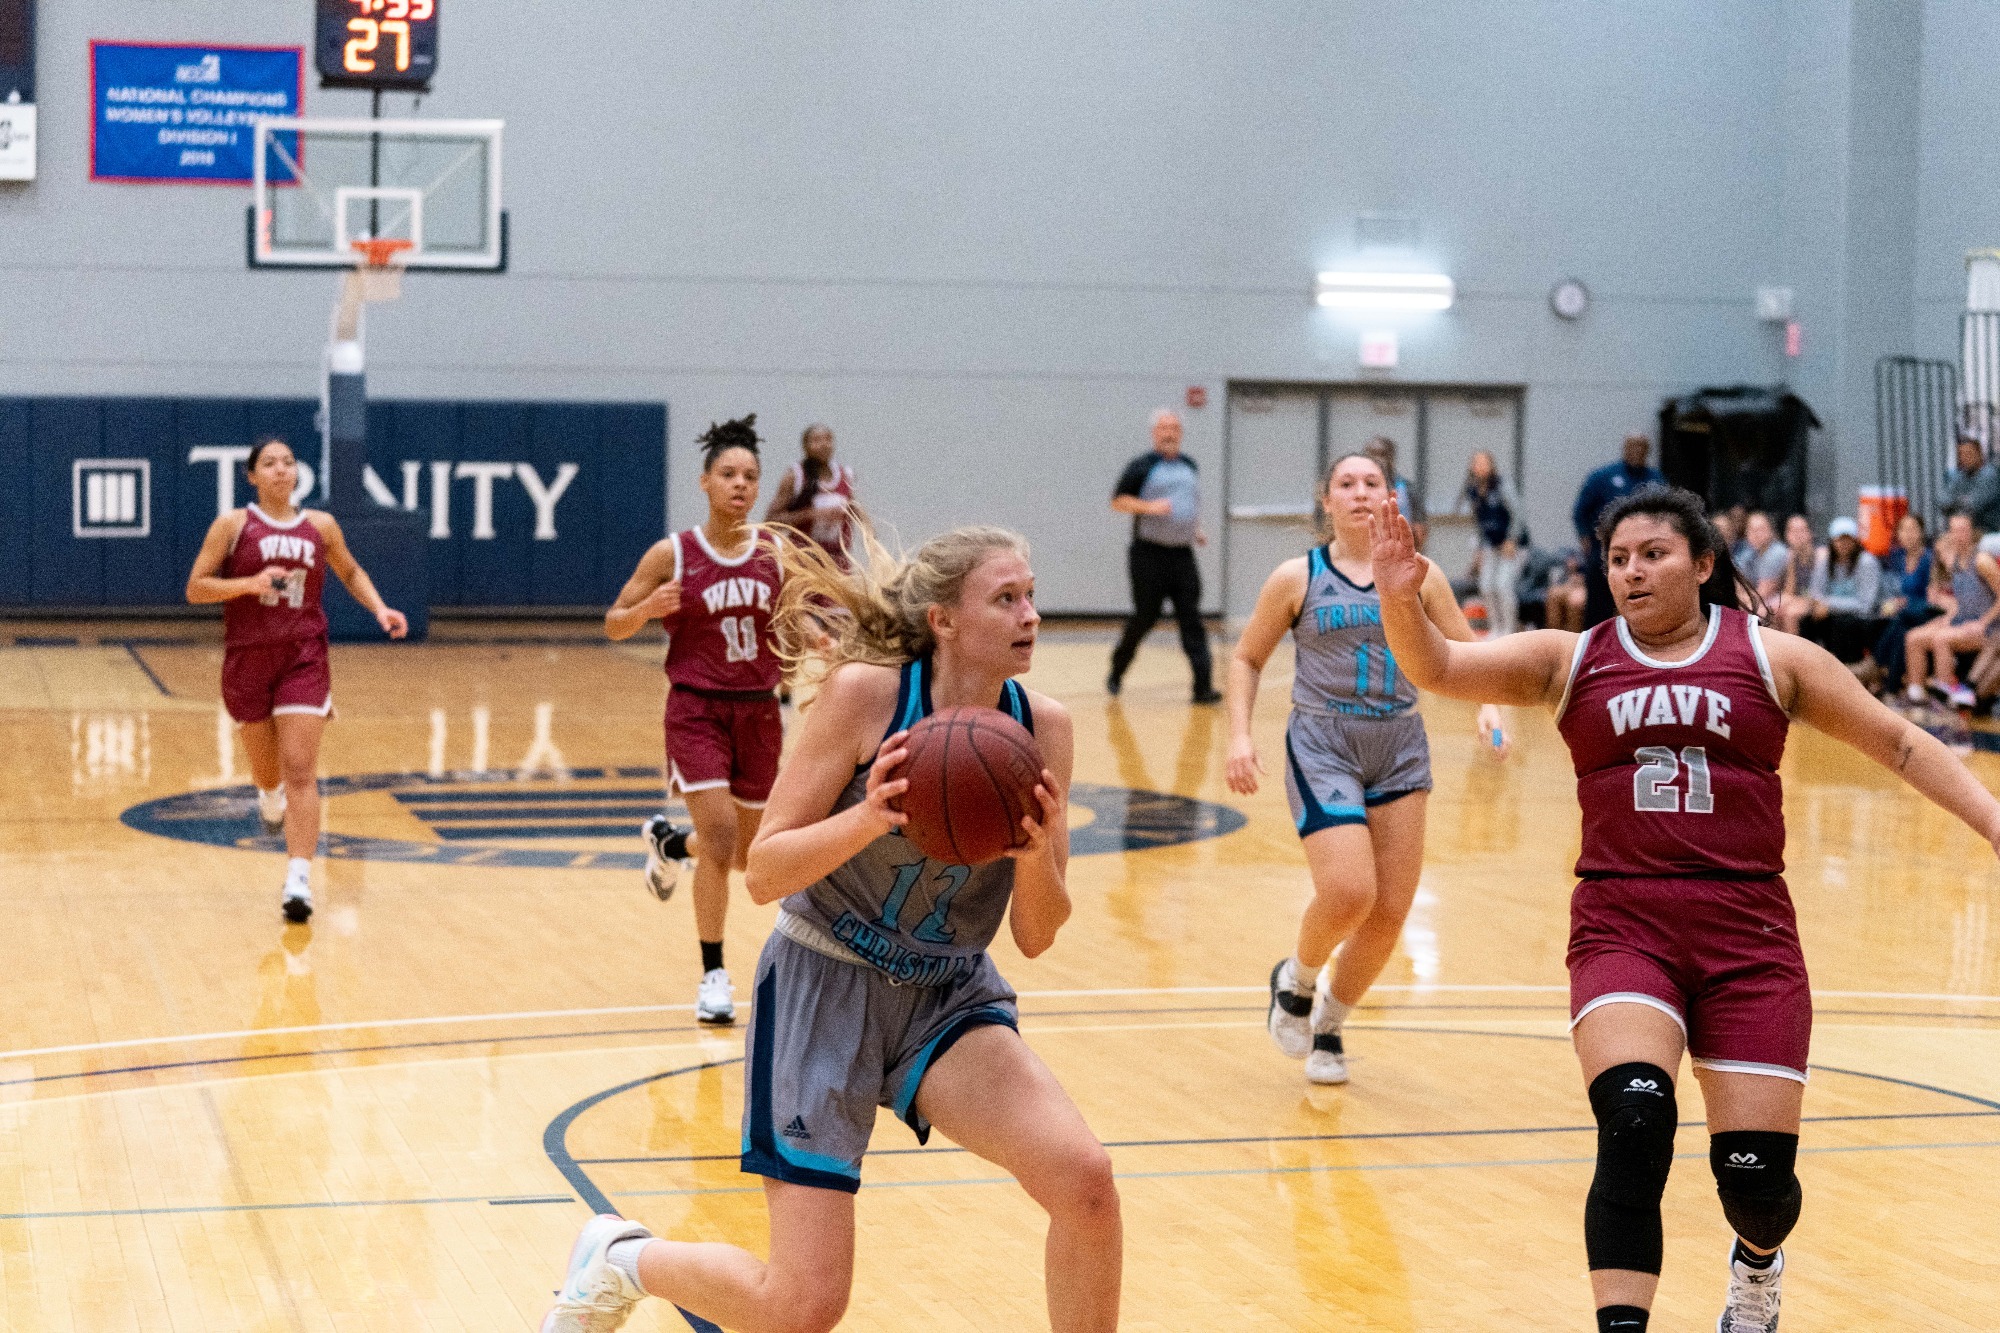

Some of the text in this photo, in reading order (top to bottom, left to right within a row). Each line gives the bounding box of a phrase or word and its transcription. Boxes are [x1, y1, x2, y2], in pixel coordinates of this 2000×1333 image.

[343, 17, 411, 73] 27
[105, 106, 184, 124] WOMEN'S
[107, 87, 288, 107] NATIONAL CHAMPIONS
[157, 128, 229, 145] DIVISION
[258, 534, 316, 569] WAVE
[701, 577, 772, 614] WAVE
[720, 615, 759, 663] 11
[1353, 637, 1397, 697] 11
[1607, 684, 1732, 741] WAVE
[1633, 745, 1715, 814] 21
[869, 856, 972, 944] 12
